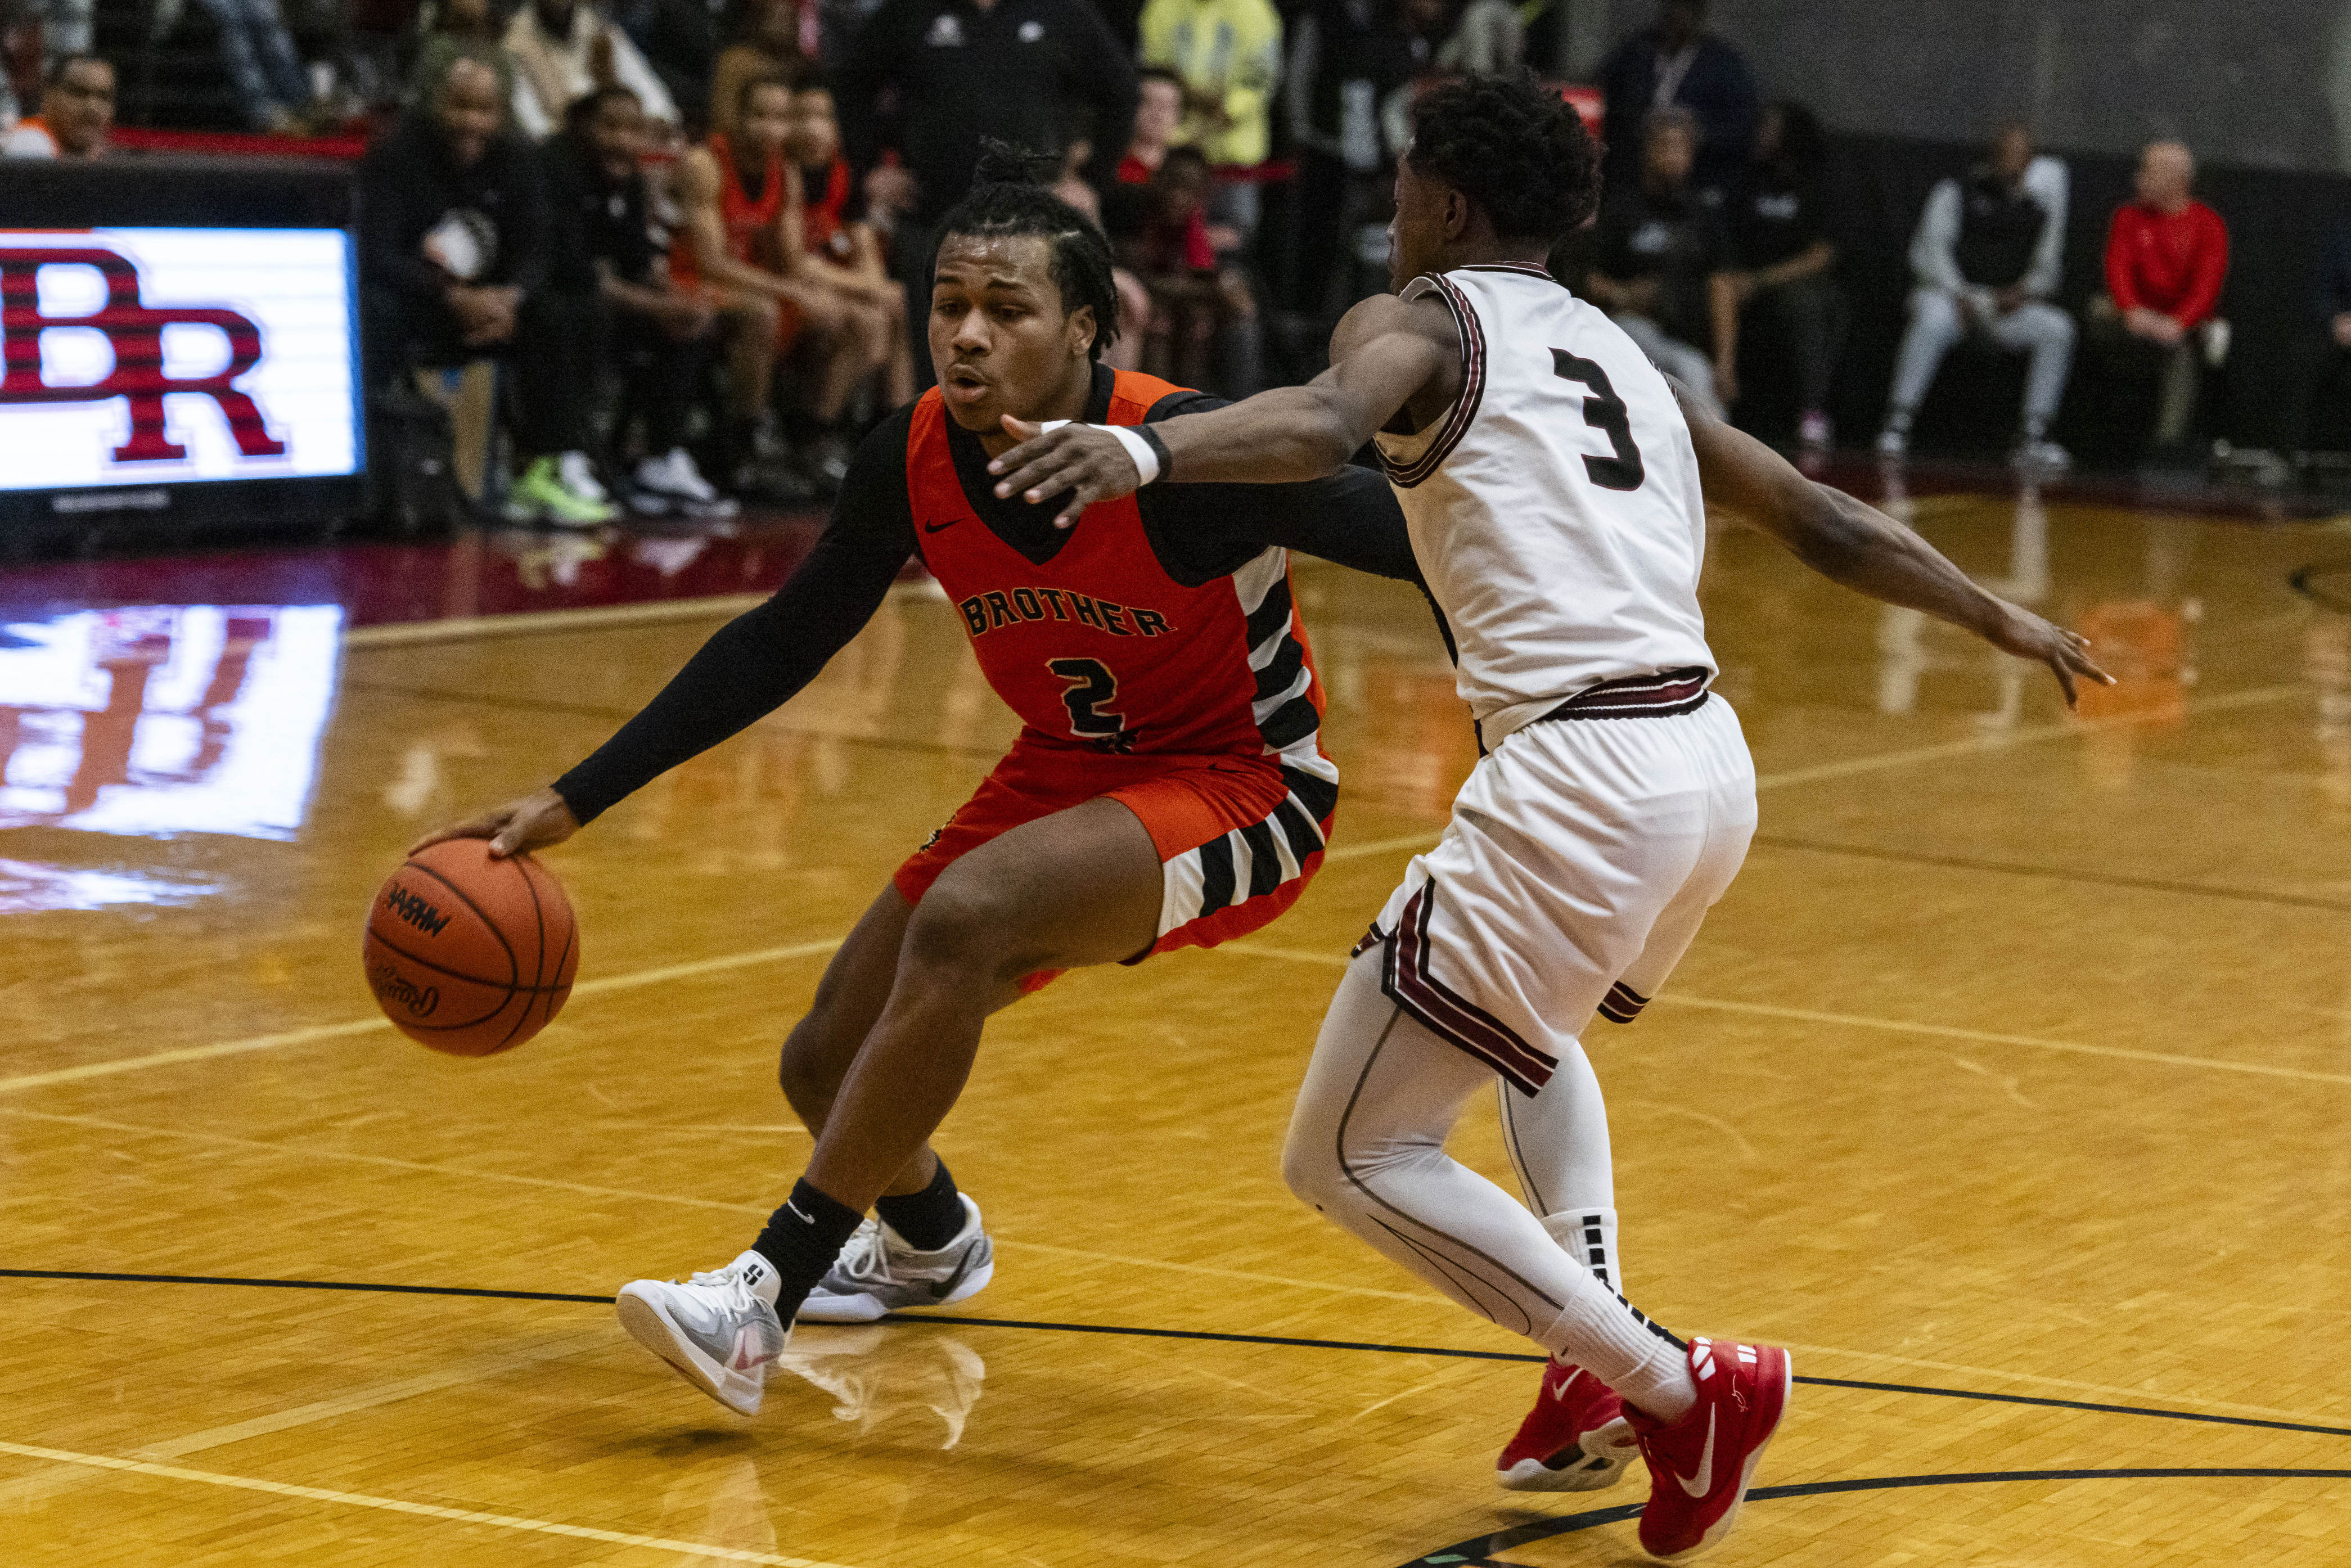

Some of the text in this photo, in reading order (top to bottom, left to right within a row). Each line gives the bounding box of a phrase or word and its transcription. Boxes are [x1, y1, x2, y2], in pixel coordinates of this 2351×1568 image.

[1548, 347, 1645, 492] 3
[958, 587, 1178, 637] BROTHER
[1045, 657, 1125, 738] 2
